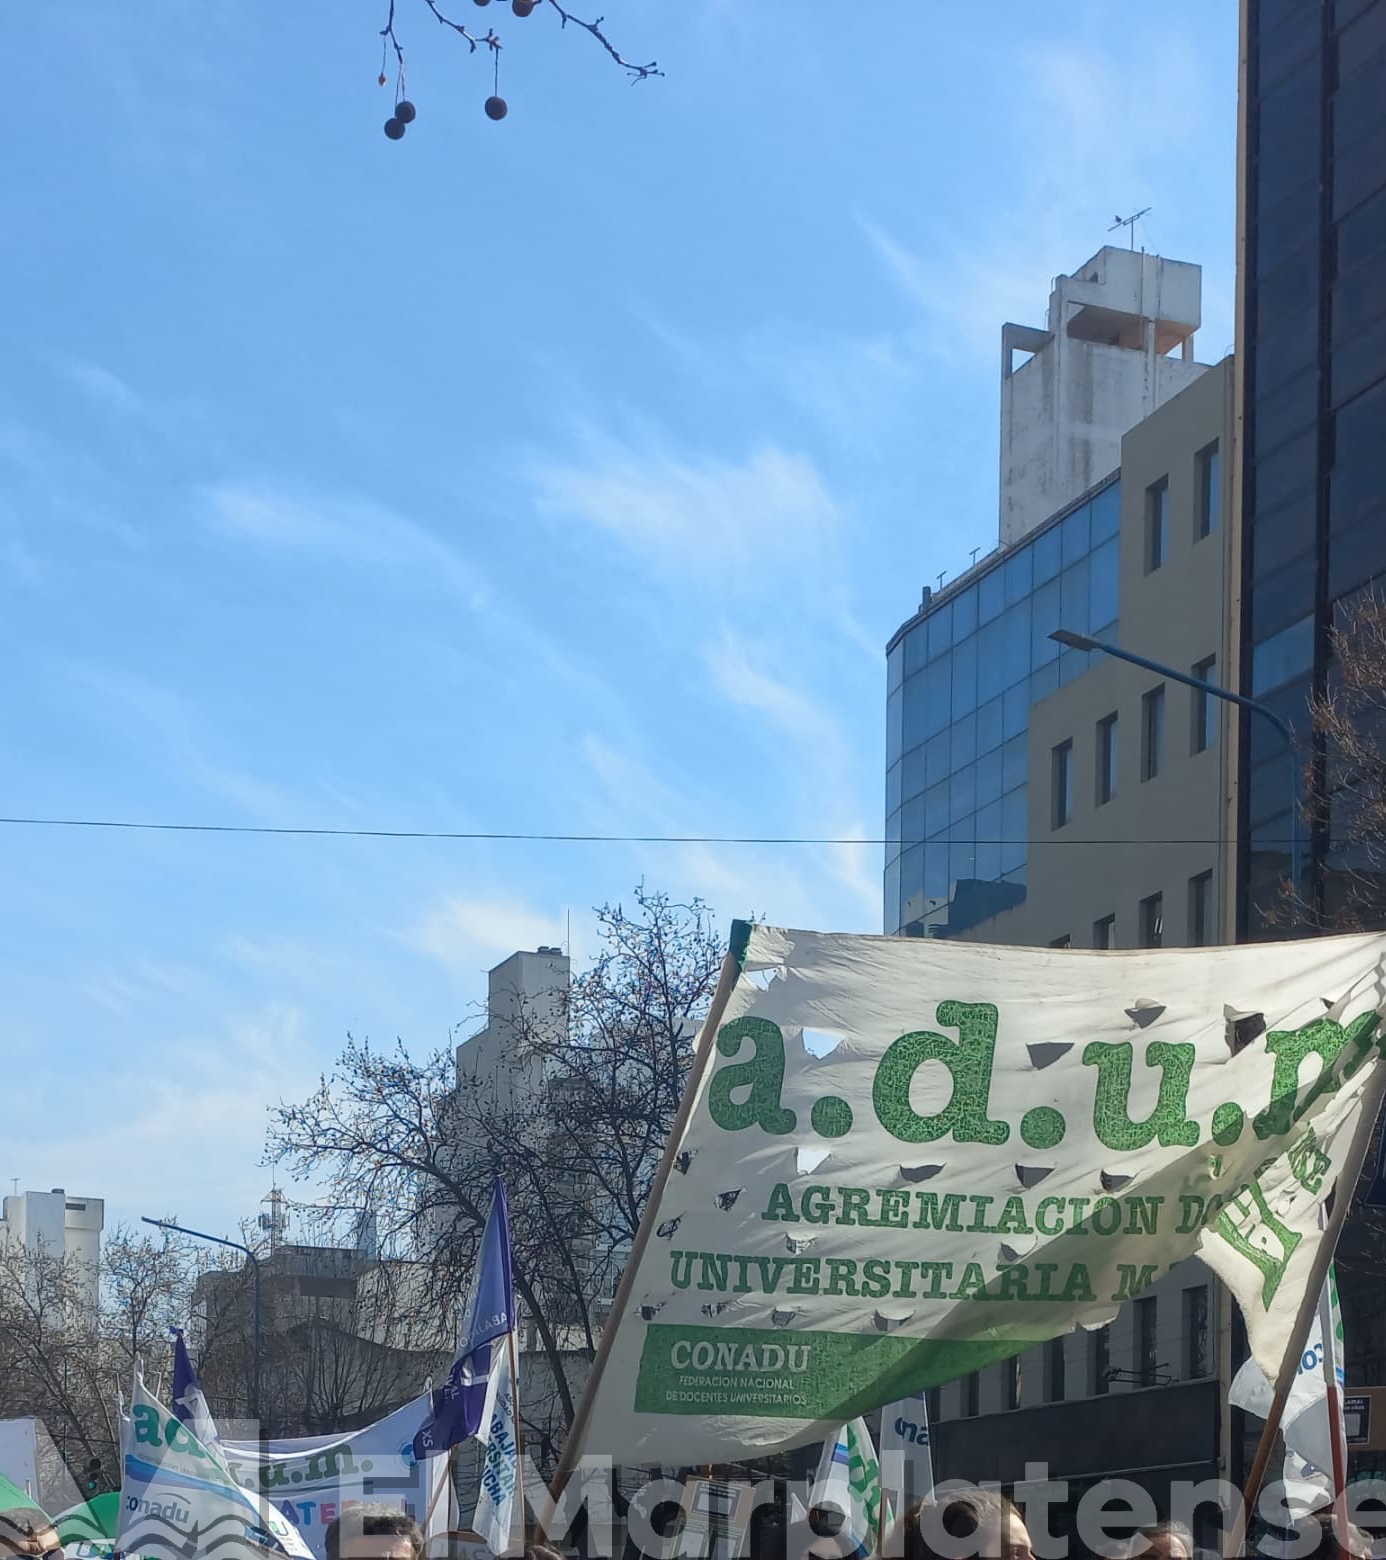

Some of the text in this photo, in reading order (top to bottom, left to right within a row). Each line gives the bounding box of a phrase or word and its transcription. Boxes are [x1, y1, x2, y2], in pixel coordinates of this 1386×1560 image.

[671, 1250, 1097, 1304] UNIVERSITARIA
[671, 1340, 812, 1374] CONADU
[740, 1376, 796, 1391] NACIONAL
